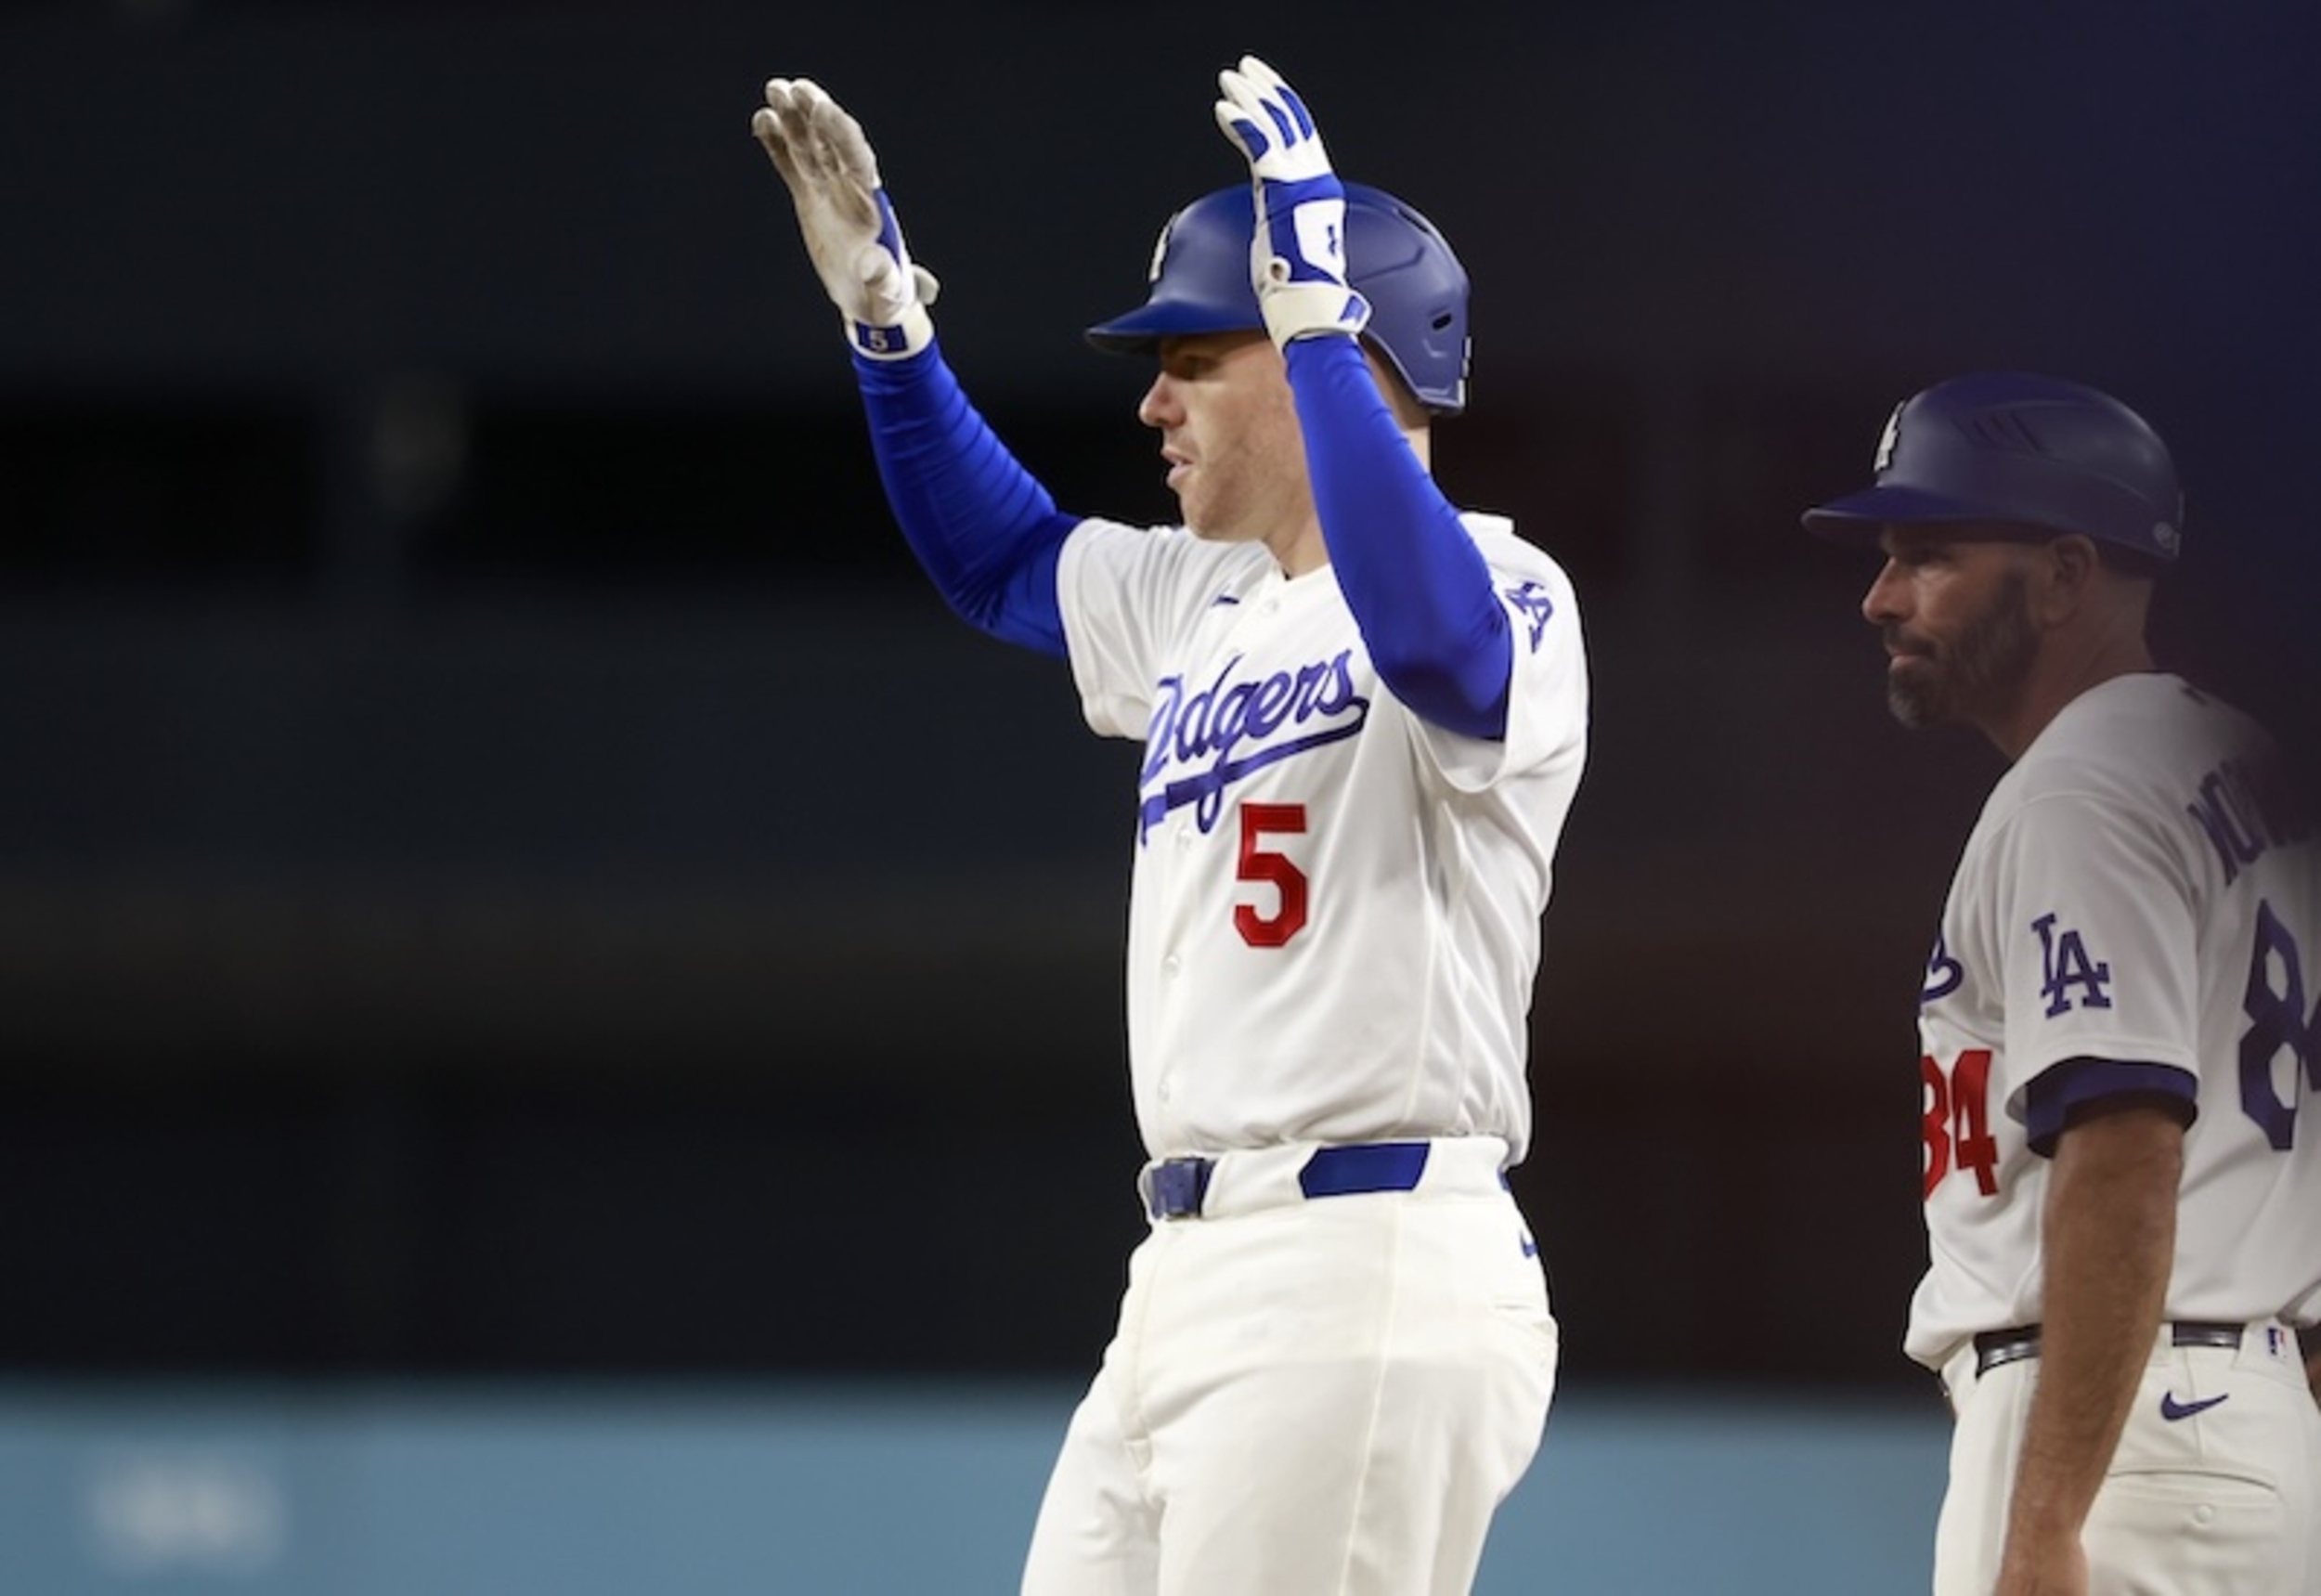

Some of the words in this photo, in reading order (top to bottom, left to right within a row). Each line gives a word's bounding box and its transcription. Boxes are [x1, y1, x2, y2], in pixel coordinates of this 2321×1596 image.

[869, 330, 888, 353] 5
[1234, 802, 1308, 948] 5
[2030, 912, 2112, 1019] LA
[2239, 898, 2321, 1151] 8
